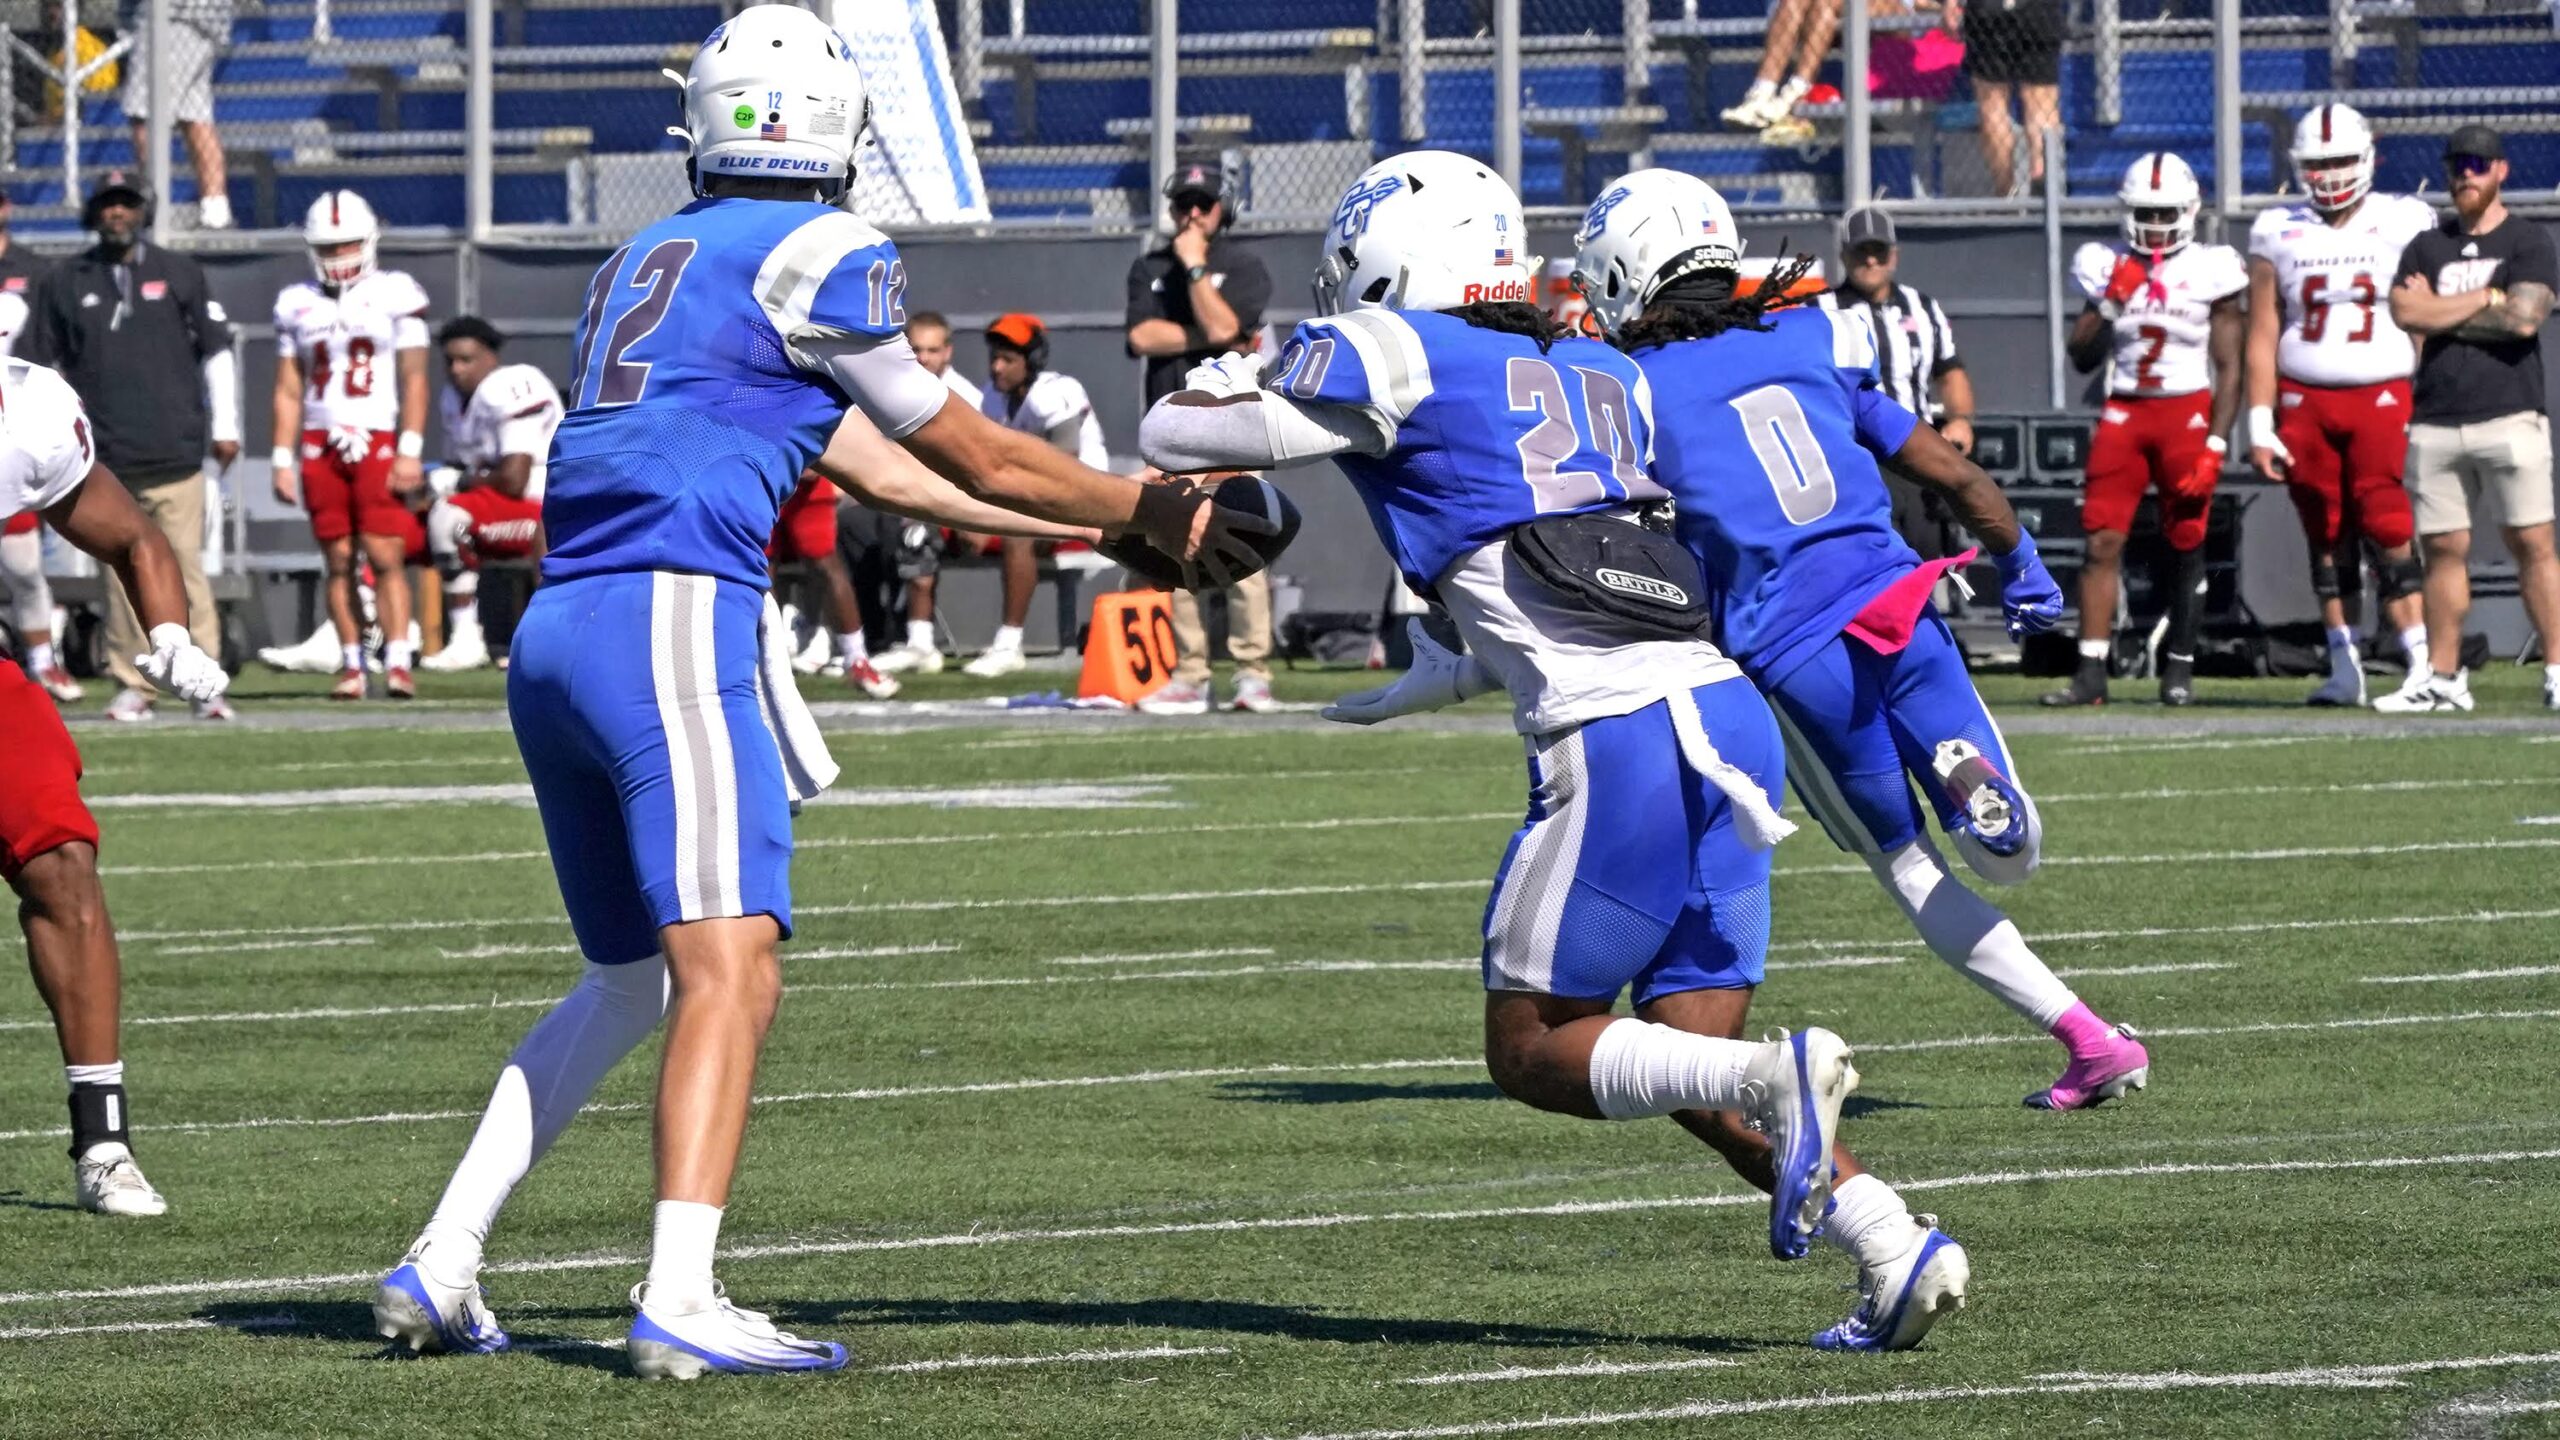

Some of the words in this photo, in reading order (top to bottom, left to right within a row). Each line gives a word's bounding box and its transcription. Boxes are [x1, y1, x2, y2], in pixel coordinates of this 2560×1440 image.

[735, 113, 754, 121] C2P
[767, 91, 783, 110] 12
[718, 157, 763, 169] BLUE
[767, 159, 829, 173] DEVILS
[1495, 214, 1507, 232] 20
[568, 238, 699, 411] 12
[866, 259, 907, 326] 12
[1266, 338, 1335, 399] 20
[2137, 323, 2167, 390] 2
[1506, 356, 1676, 514] 20
[1728, 384, 1836, 526] 0
[1605, 571, 1681, 600] BATTLE
[1121, 605, 1178, 685] 50
